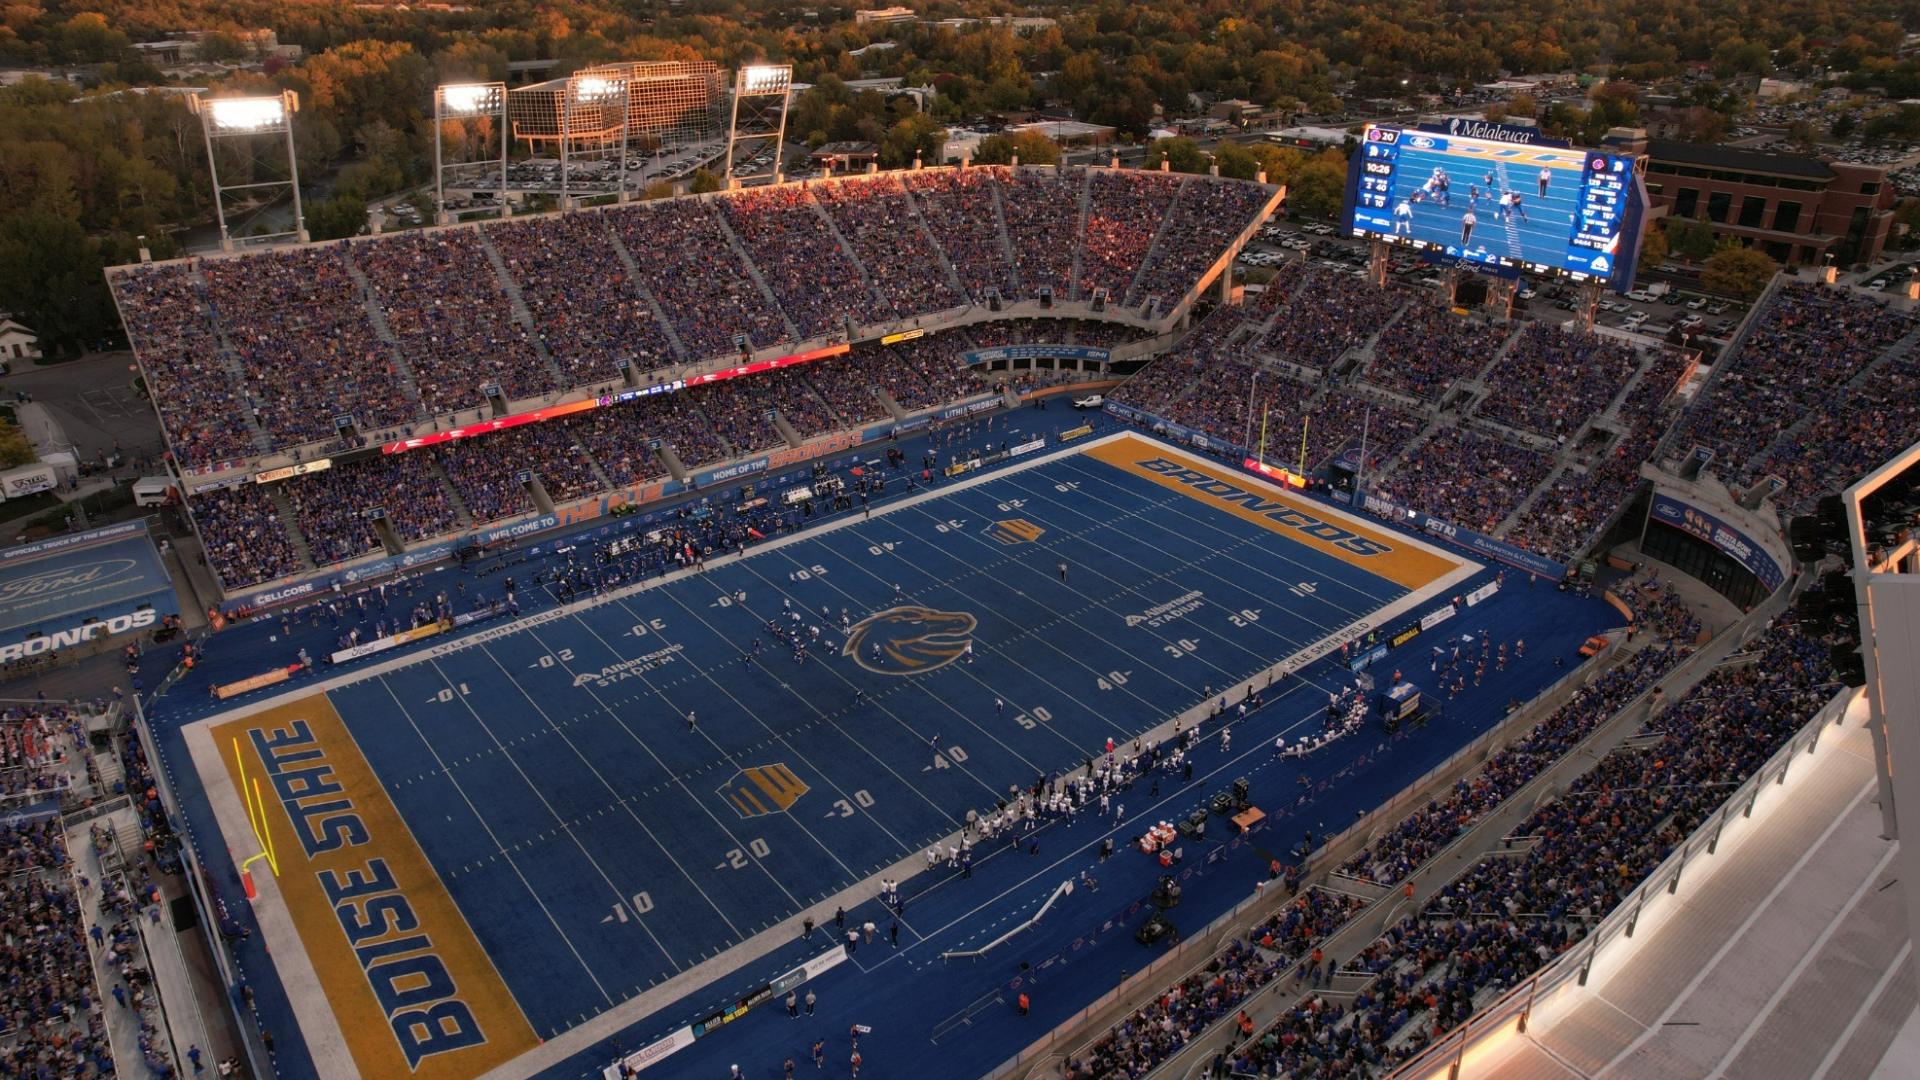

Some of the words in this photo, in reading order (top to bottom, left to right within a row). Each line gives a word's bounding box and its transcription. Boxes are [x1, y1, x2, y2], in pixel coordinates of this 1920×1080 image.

[1461, 121, 1530, 144] Melaleuca
[713, 466, 736, 481] HOME
[738, 463, 750, 474] OF
[751, 459, 767, 471] THE
[1134, 457, 1393, 557] BRONCOS
[489, 519, 540, 541] WELCOME
[541, 516, 555, 529] TO
[256, 582, 313, 606] CELLCORE
[1147, 600, 1204, 628] STADIUM
[1228, 609, 1260, 628] 20
[0, 608, 156, 663] RONCOS
[431, 637, 471, 655] LYLE
[475, 623, 521, 643] SMITH
[523, 609, 565, 627] FIELD
[632, 618, 667, 637] 30
[351, 642, 377, 657] Ford
[1163, 639, 1195, 659] 30
[1311, 637, 1344, 655] SMITH
[540, 648, 574, 669] 20
[602, 643, 684, 676] Albertsons
[438, 683, 472, 703] 10
[1097, 670, 1129, 692] 40
[1014, 706, 1052, 730] 50
[934, 745, 969, 770] 40
[247, 719, 371, 862] STATE
[833, 788, 876, 818] 30
[726, 838, 771, 870] 20
[611, 891, 655, 924] 10
[315, 858, 489, 1074] BOISE
